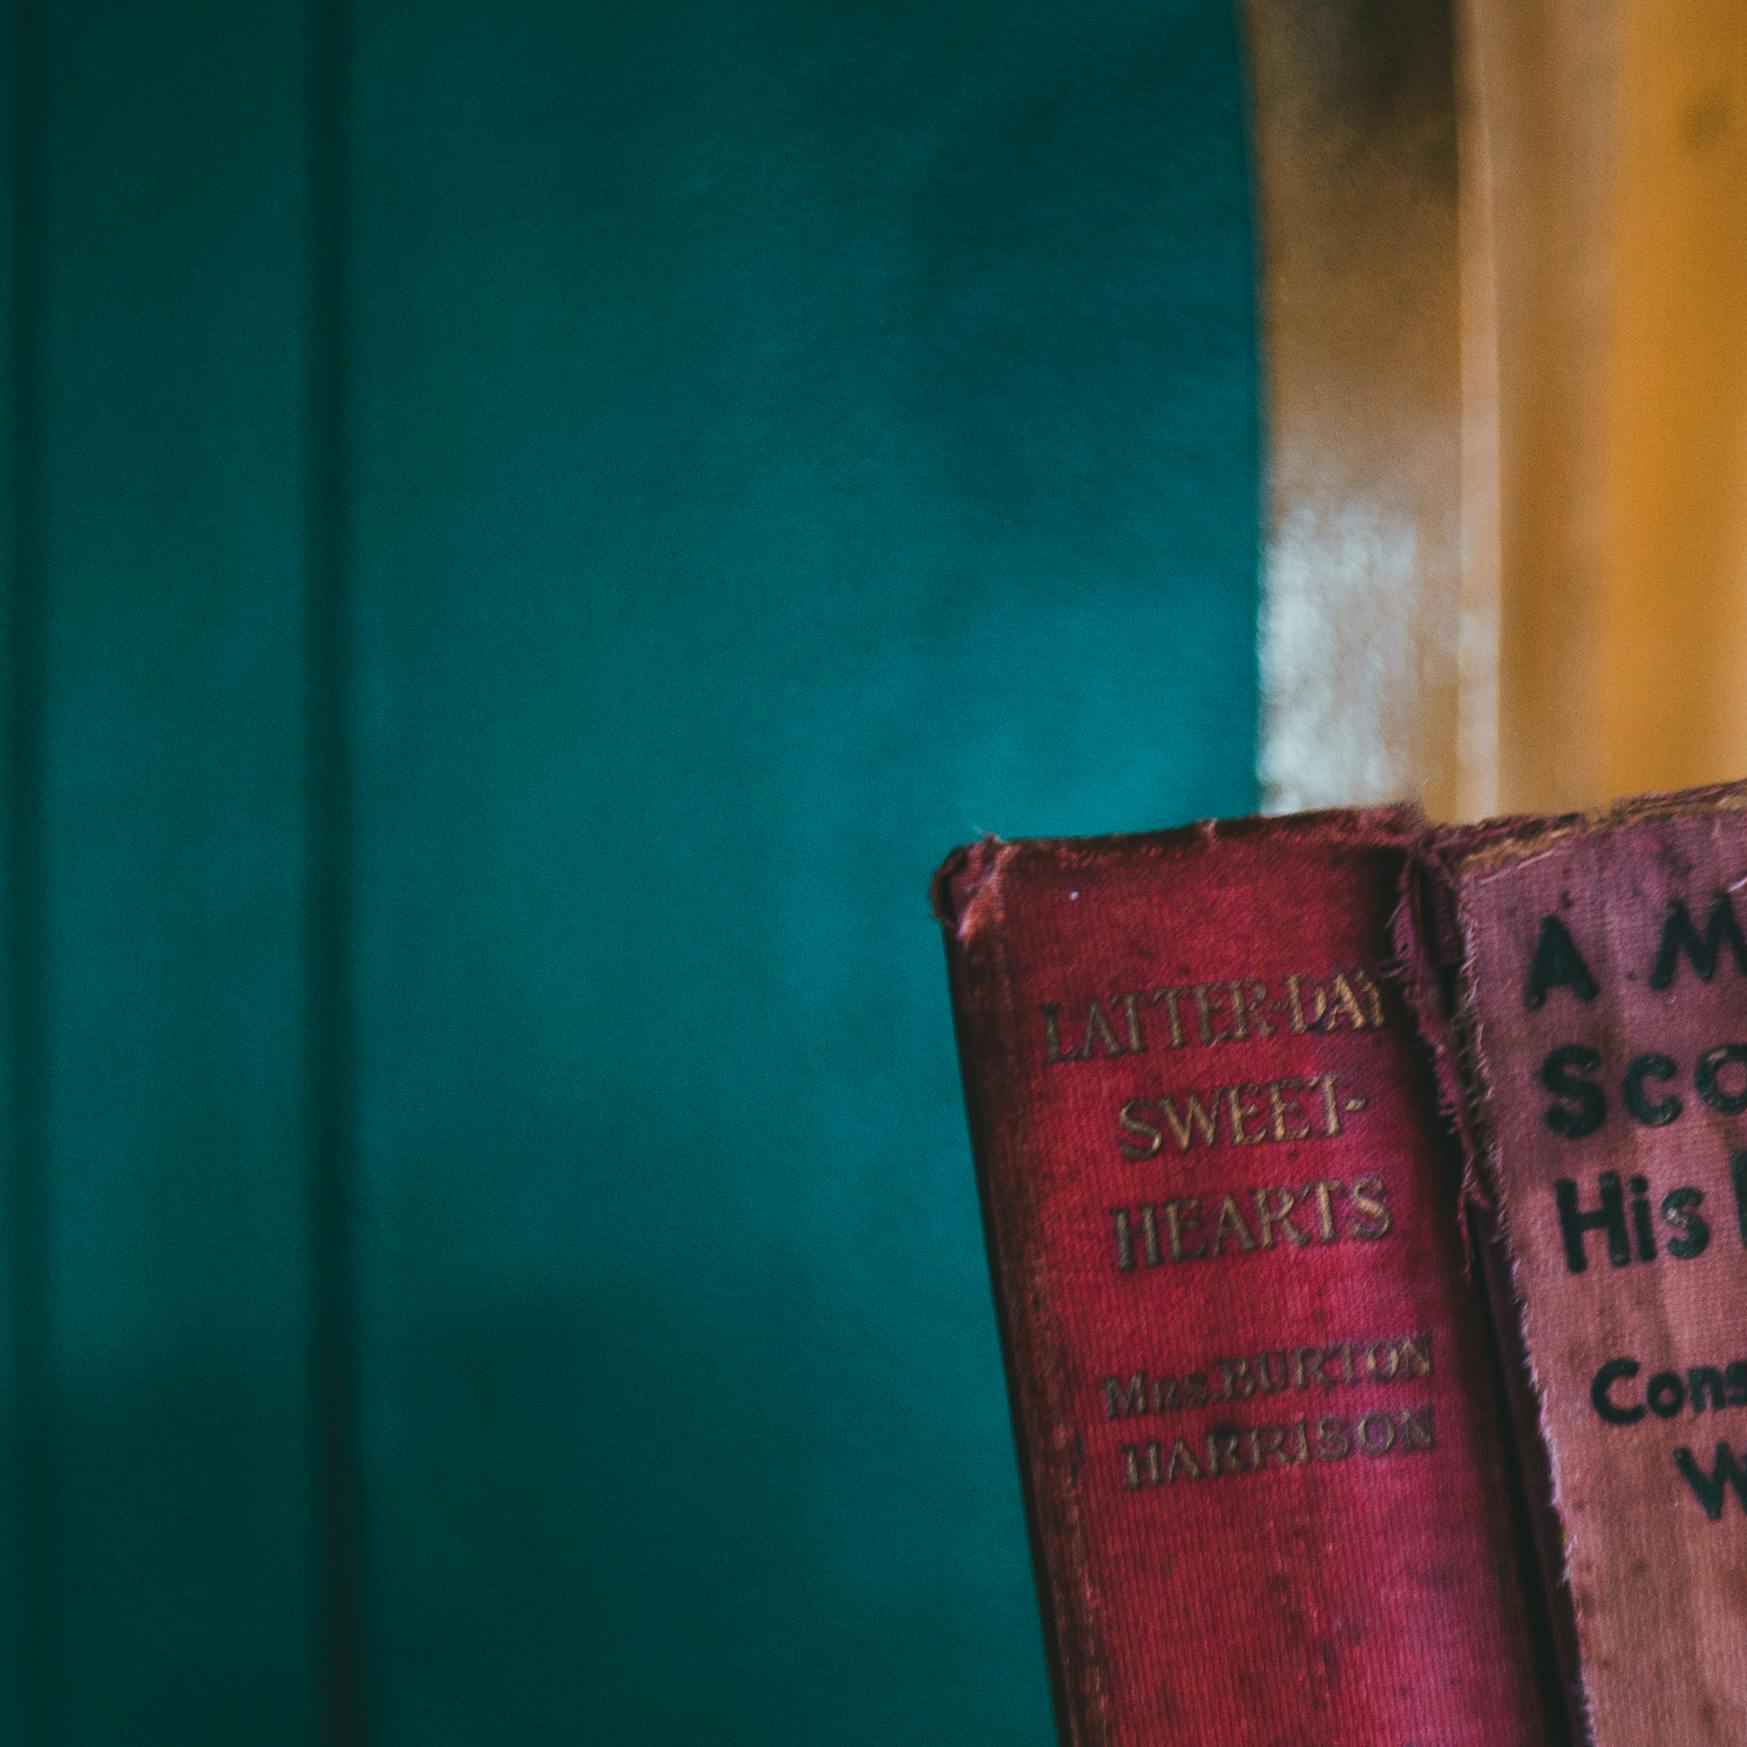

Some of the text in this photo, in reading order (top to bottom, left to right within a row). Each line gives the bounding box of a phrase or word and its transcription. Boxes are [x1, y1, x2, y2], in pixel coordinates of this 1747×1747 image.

[1522, 912, 1599, 1011] A
[1116, 1072, 1370, 1162] SWEET-
[1108, 1176, 1394, 1274] HEARTS
[1552, 1170, 1711, 1274] His
[1118, 1403, 1437, 1492] HARRISON
